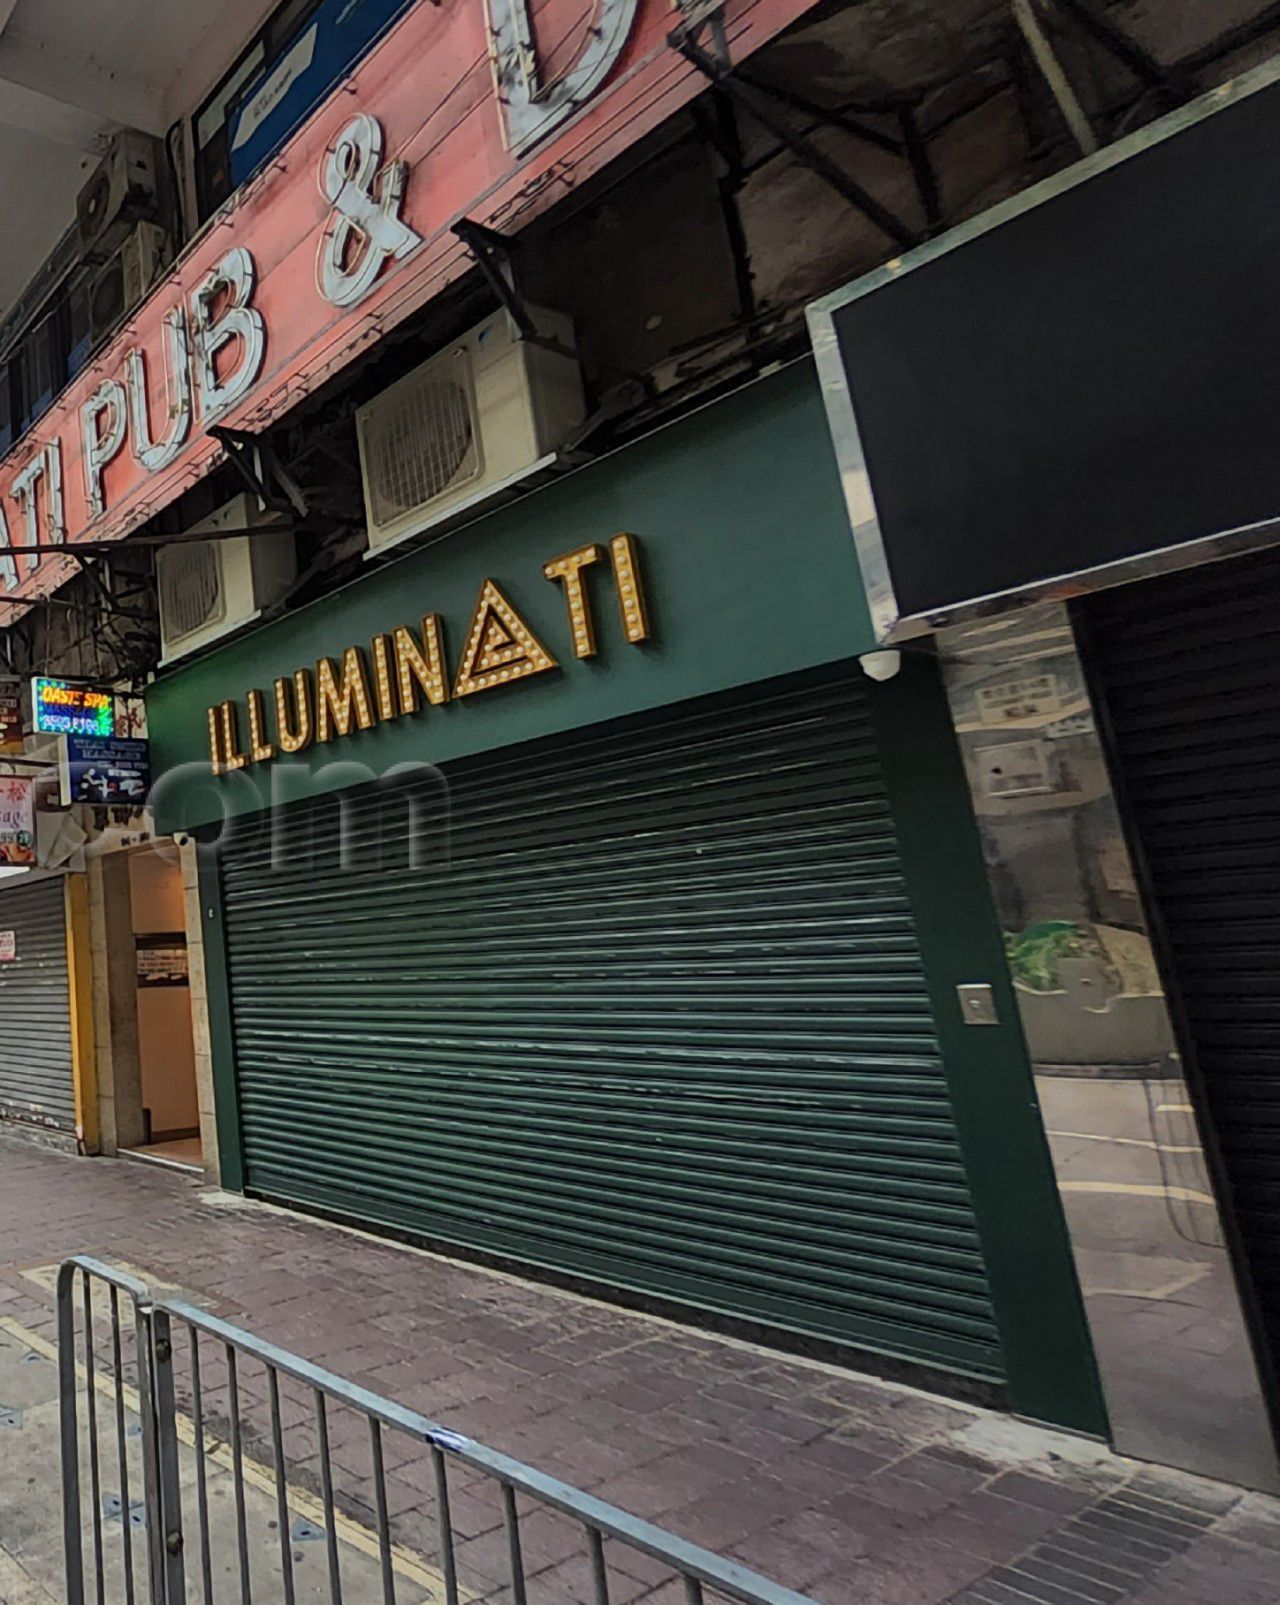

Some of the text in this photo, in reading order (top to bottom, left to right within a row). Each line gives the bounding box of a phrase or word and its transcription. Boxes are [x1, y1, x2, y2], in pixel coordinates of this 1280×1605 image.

[79, 247, 268, 521] PUB
[316, 112, 424, 308] &
[209, 532, 650, 776] ILLUMINATI
